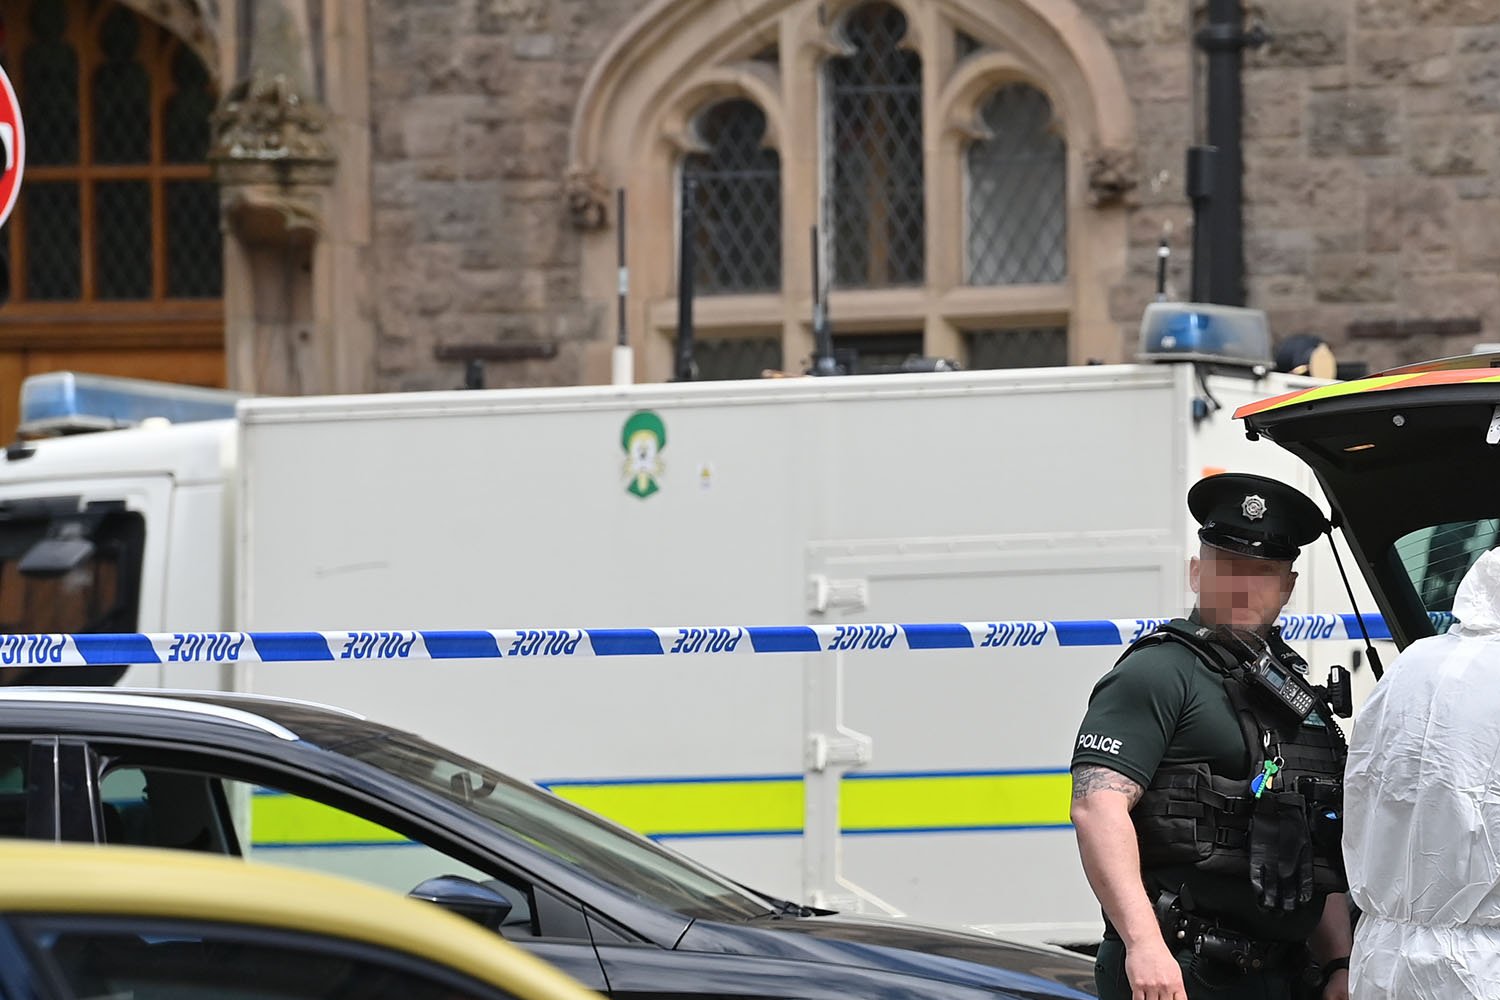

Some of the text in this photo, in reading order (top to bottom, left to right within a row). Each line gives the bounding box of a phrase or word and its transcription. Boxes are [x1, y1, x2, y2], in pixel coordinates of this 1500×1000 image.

[168, 633, 244, 661] POLICE
[341, 632, 416, 659] POLICE
[508, 630, 582, 656] POLICE
[671, 627, 743, 653] POLICE
[827, 625, 897, 650] POLICE
[981, 621, 1048, 648] POLICE
[1077, 734, 1123, 755] POLICE
